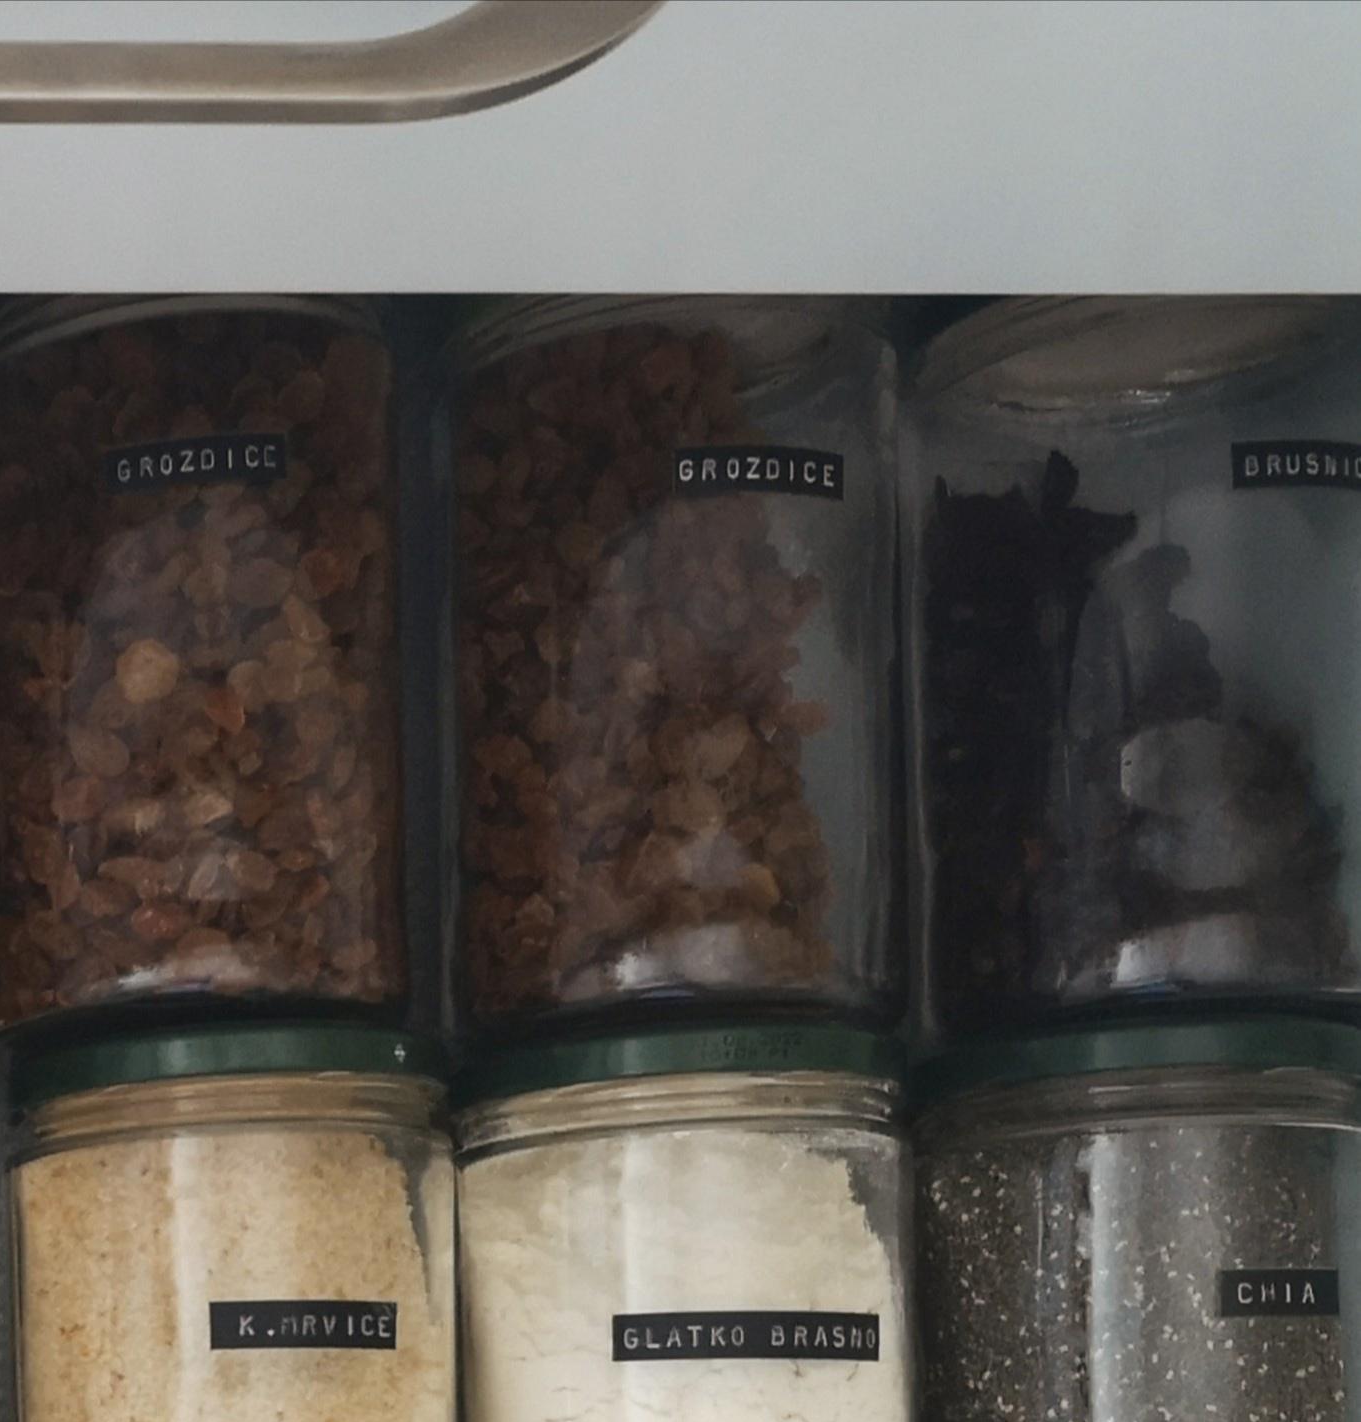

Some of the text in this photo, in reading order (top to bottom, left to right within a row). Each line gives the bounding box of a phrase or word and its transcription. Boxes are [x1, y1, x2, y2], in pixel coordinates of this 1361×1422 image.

[116, 444, 278, 482] GROZDICE
[678, 456, 836, 488] GROZDICE
[1236, 1281, 1317, 1306] CHIA
[237, 1314, 393, 1339] K.MRVICE
[622, 1323, 876, 1351] GLATKO BRASNO
